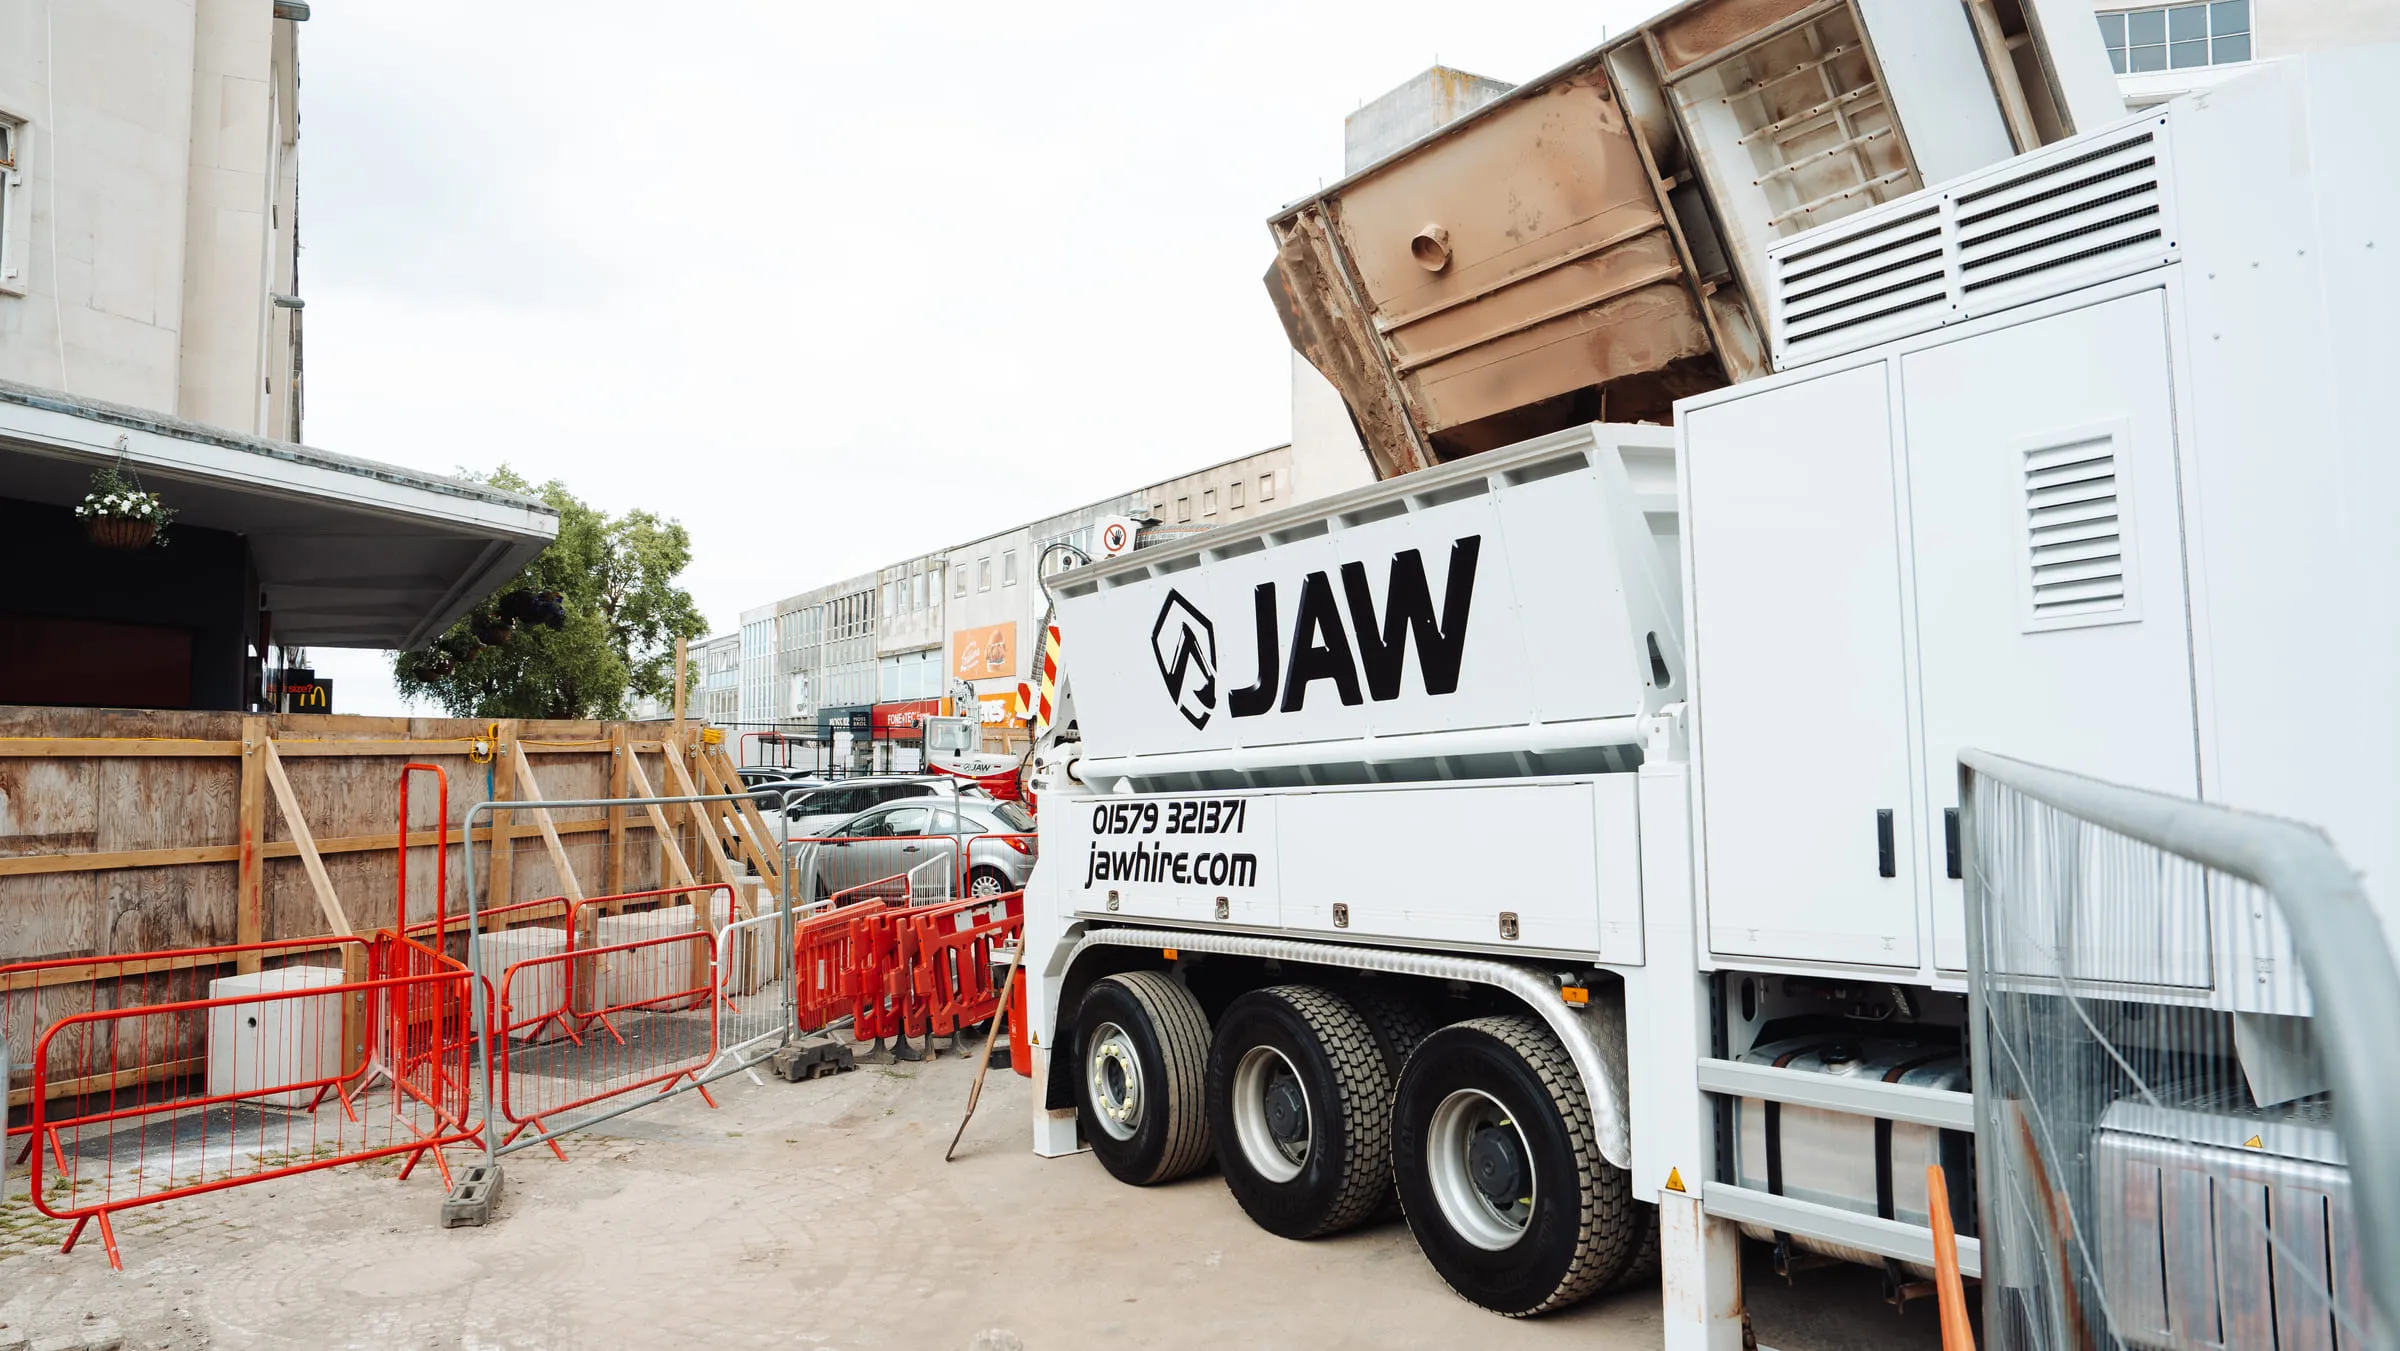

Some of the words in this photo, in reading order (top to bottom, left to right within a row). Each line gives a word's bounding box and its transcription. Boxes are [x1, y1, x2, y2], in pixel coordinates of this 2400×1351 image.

[1228, 534, 1481, 718] JAW
[288, 683, 313, 693] size?
[971, 764, 991, 772] JAW
[1093, 802, 1159, 834] 01579
[1165, 799, 1247, 834] 321371
[1084, 841, 1257, 889] jawhire.com
